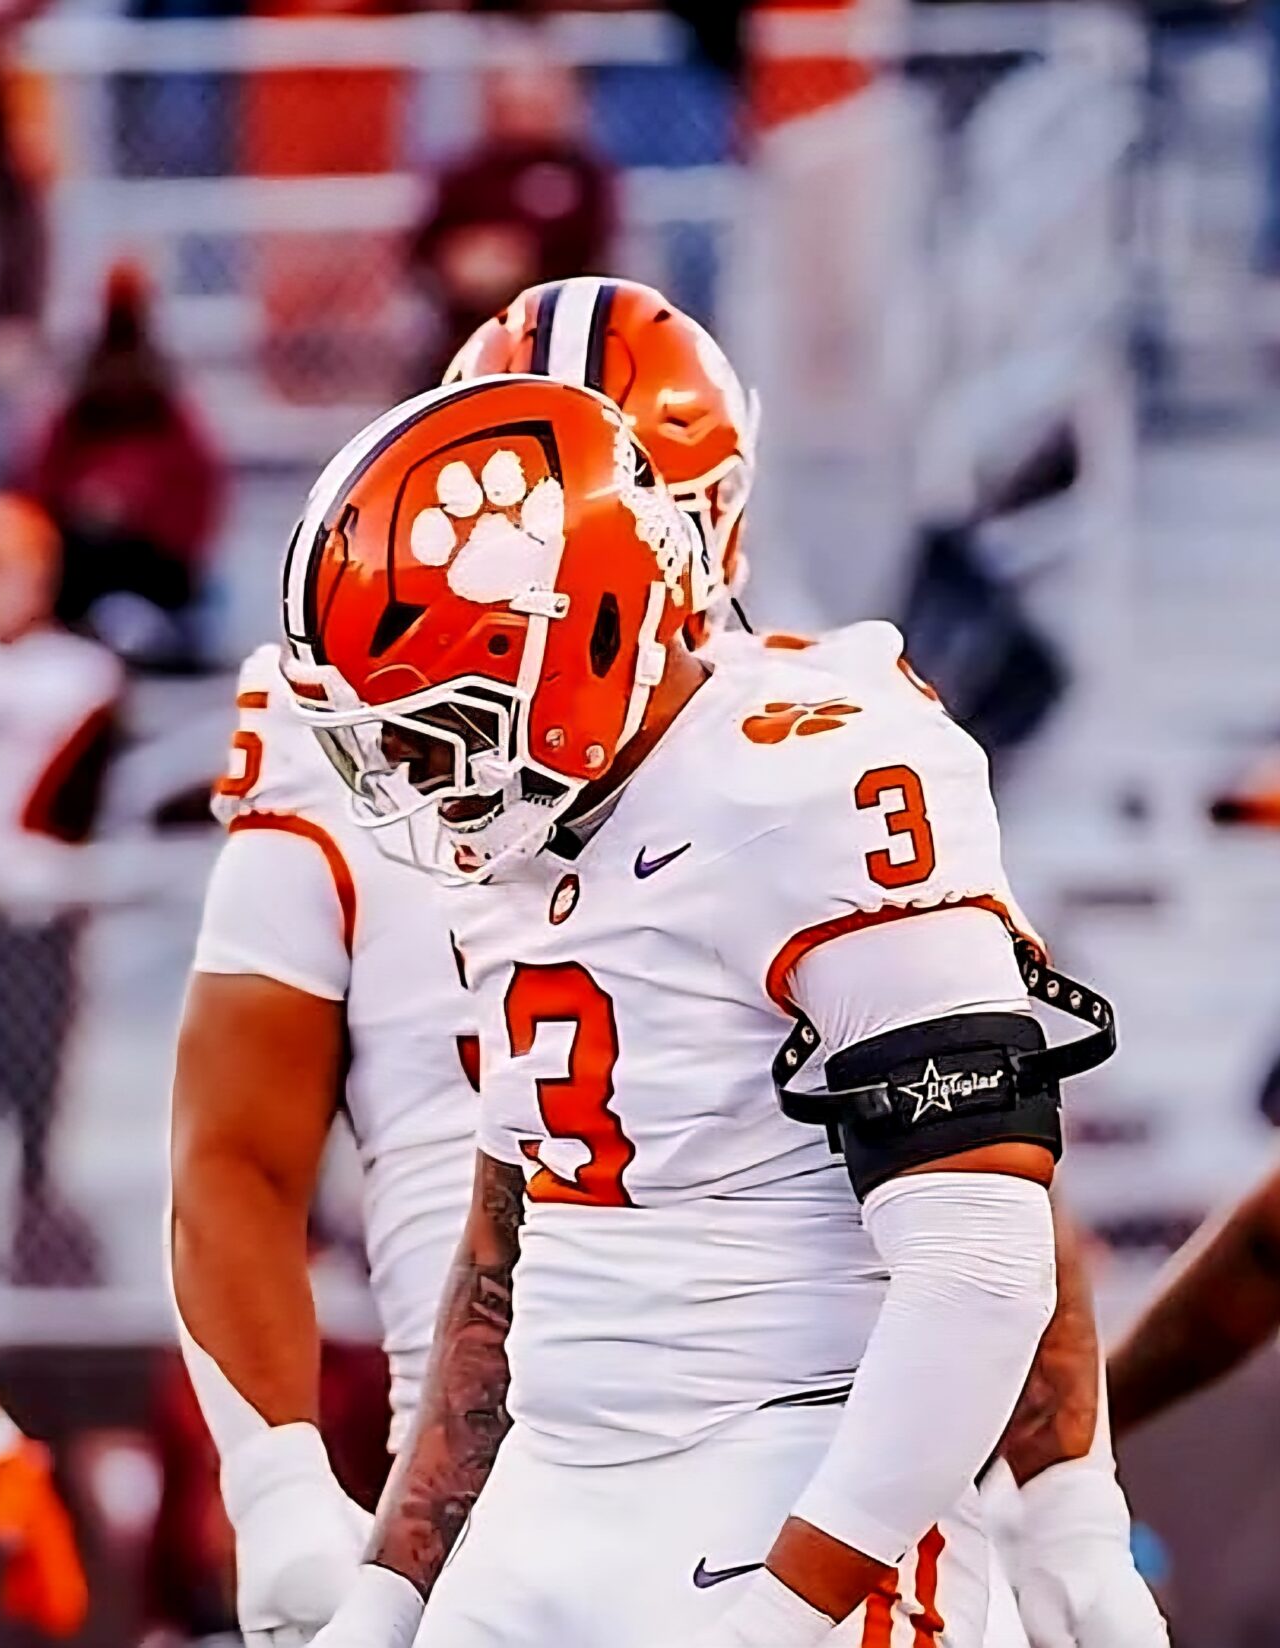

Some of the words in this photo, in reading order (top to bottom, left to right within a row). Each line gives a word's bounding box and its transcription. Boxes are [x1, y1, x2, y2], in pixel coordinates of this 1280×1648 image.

[854, 764, 936, 889] 3
[504, 960, 636, 1208] 3
[927, 1071, 1001, 1100] Douglas
